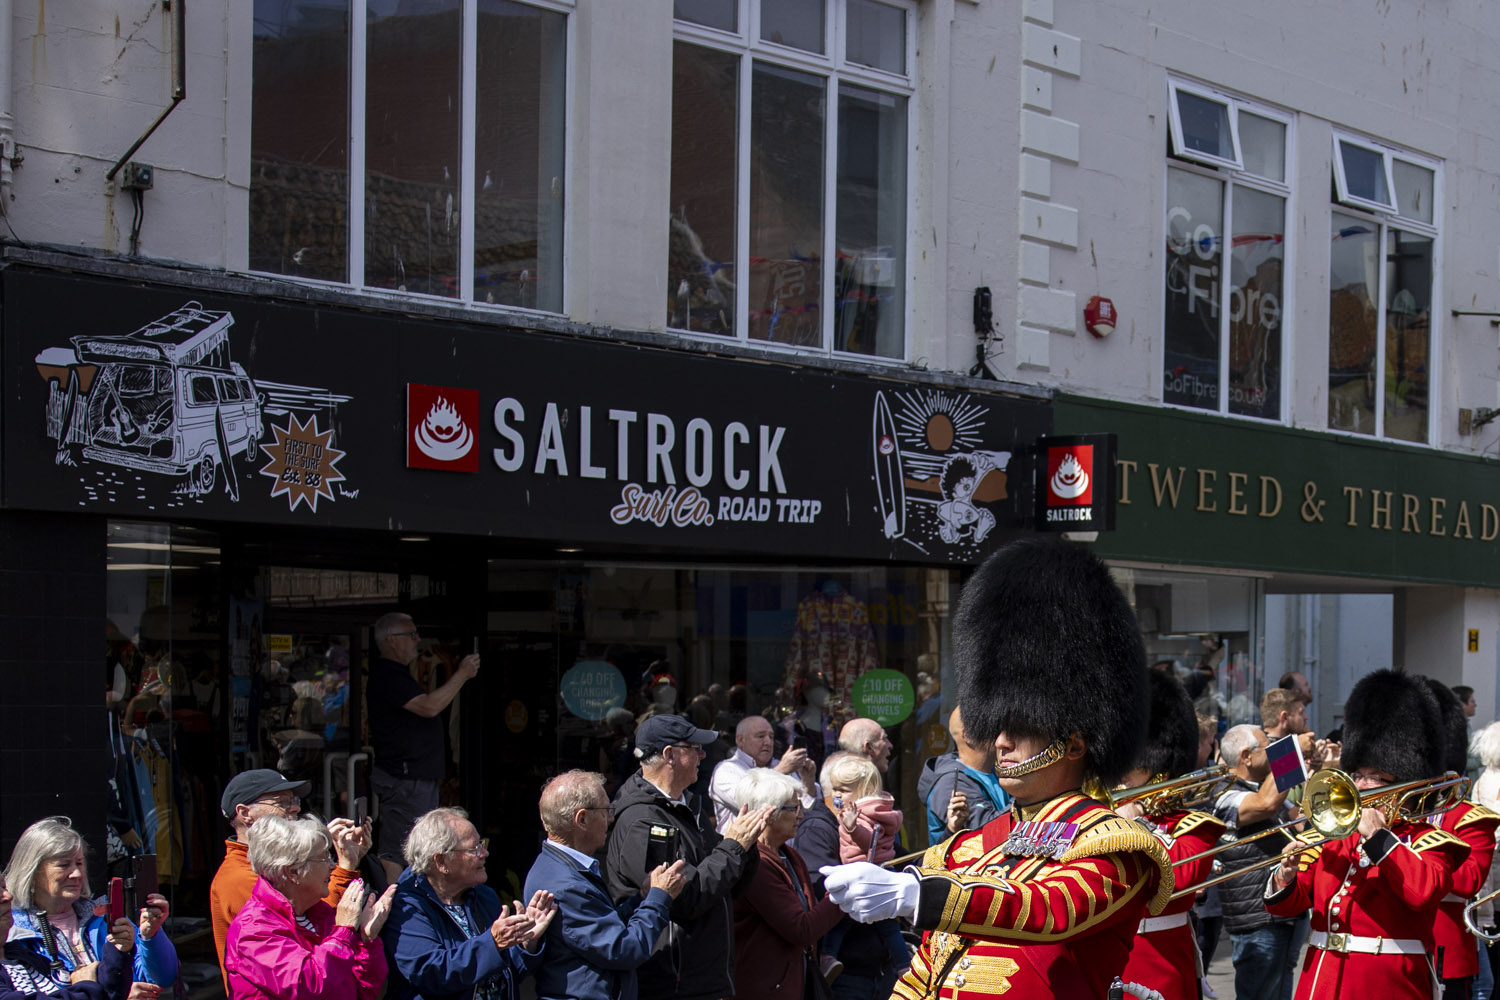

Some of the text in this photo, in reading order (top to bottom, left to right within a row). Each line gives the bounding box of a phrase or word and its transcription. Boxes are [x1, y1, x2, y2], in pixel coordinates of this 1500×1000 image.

[1167, 206, 1216, 260] Go
[284, 438, 323, 459] FIRST TO
[492, 397, 787, 494] SALTROCK
[285, 453, 320, 471] THE SURF
[1116, 459, 1284, 518] TWEED
[1300, 480, 1326, 522] &
[610, 483, 822, 527] Surf Co. ROAD TRIP
[1046, 507, 1093, 522] SALTROCK
[862, 679, 903, 692] £10 OFF
[862, 694, 904, 704] CHANGING
[866, 705, 900, 715] TOWELS
